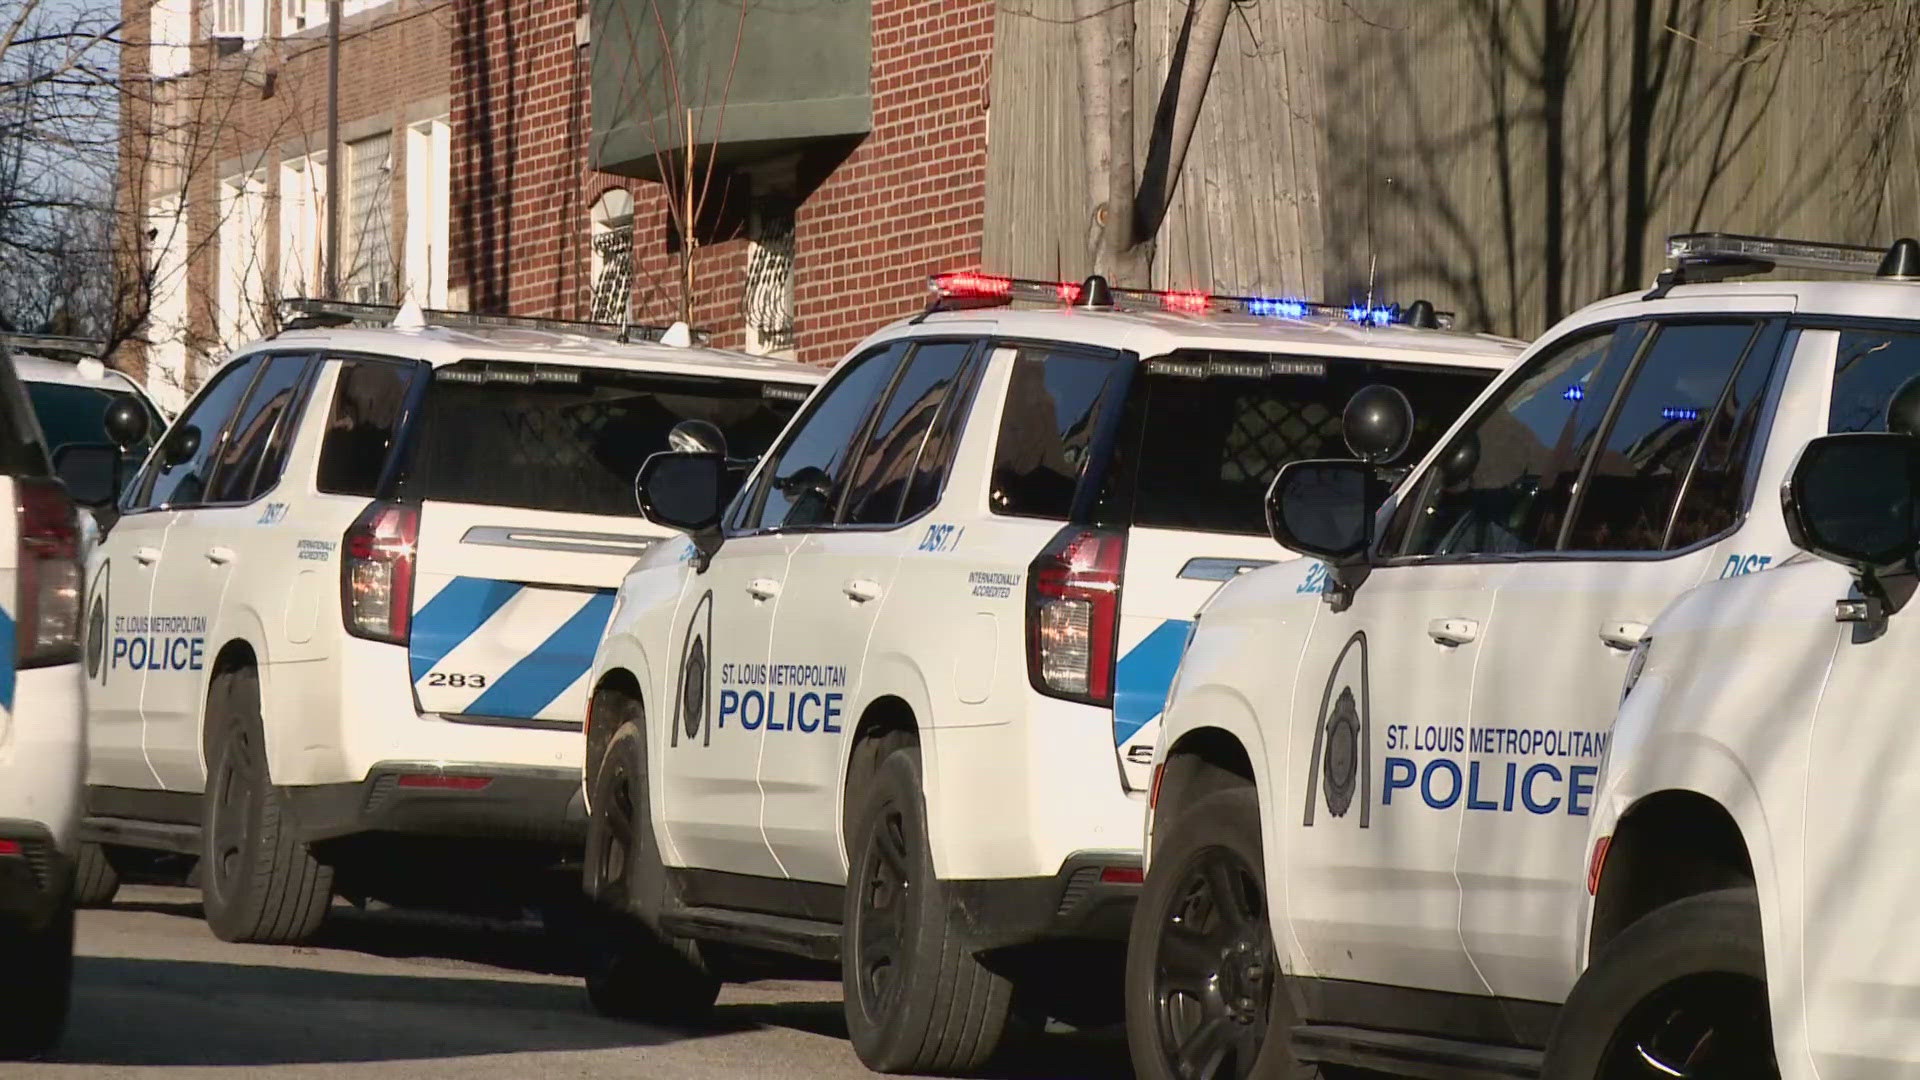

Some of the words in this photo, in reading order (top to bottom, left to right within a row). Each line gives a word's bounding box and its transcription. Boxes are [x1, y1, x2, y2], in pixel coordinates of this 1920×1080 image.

[968, 571, 1021, 586] INTERNATIONALLY
[972, 586, 1010, 598] ACCREDITED
[127, 616, 149, 633] LOUIS
[150, 616, 207, 633] METROPOLITAN
[112, 637, 204, 670] POLICE
[429, 672, 486, 688] 283
[722, 663, 735, 684] ST.
[738, 664, 766, 685] LOUIS
[769, 665, 846, 687] METROPOLITAN
[719, 690, 843, 733] POLICE
[1386, 724, 1408, 750] ST.
[1415, 726, 1464, 752] LOUIS
[1470, 728, 1606, 758] METROPOLITAN
[1382, 757, 1598, 816] POLICE
